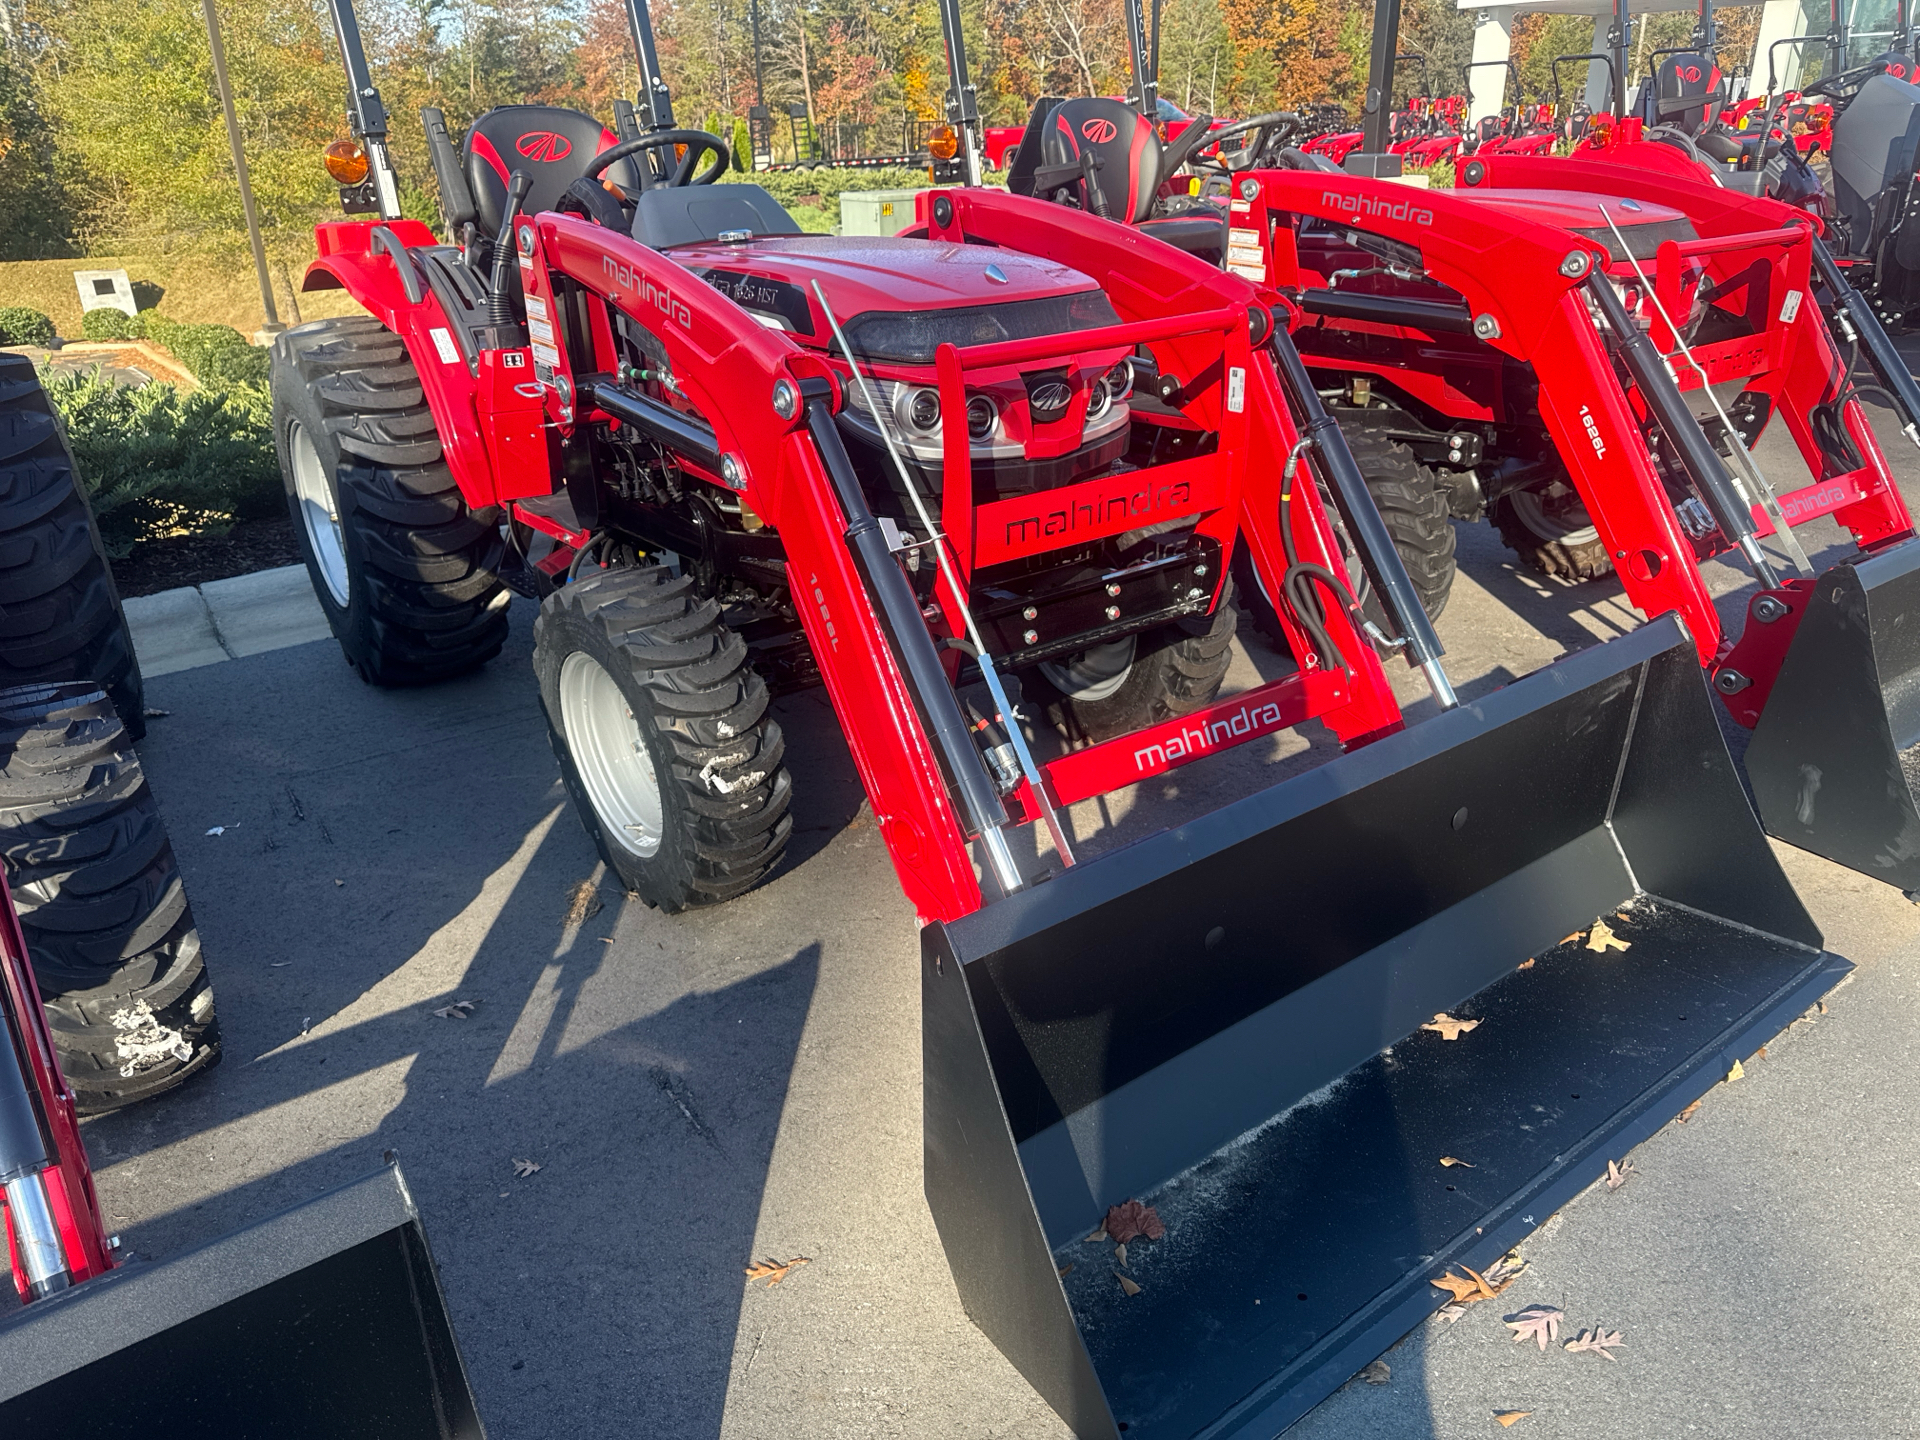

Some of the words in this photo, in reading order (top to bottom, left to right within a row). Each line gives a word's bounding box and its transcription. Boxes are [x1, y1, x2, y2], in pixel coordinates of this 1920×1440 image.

[1322, 191, 1434, 225] mahindra
[603, 254, 691, 330] mahindra
[757, 286, 779, 305] HST
[1578, 404, 1607, 461] 1626L
[1006, 481, 1191, 546] mahindra
[810, 572, 839, 653] 1626L
[1134, 702, 1282, 771] mahindra
